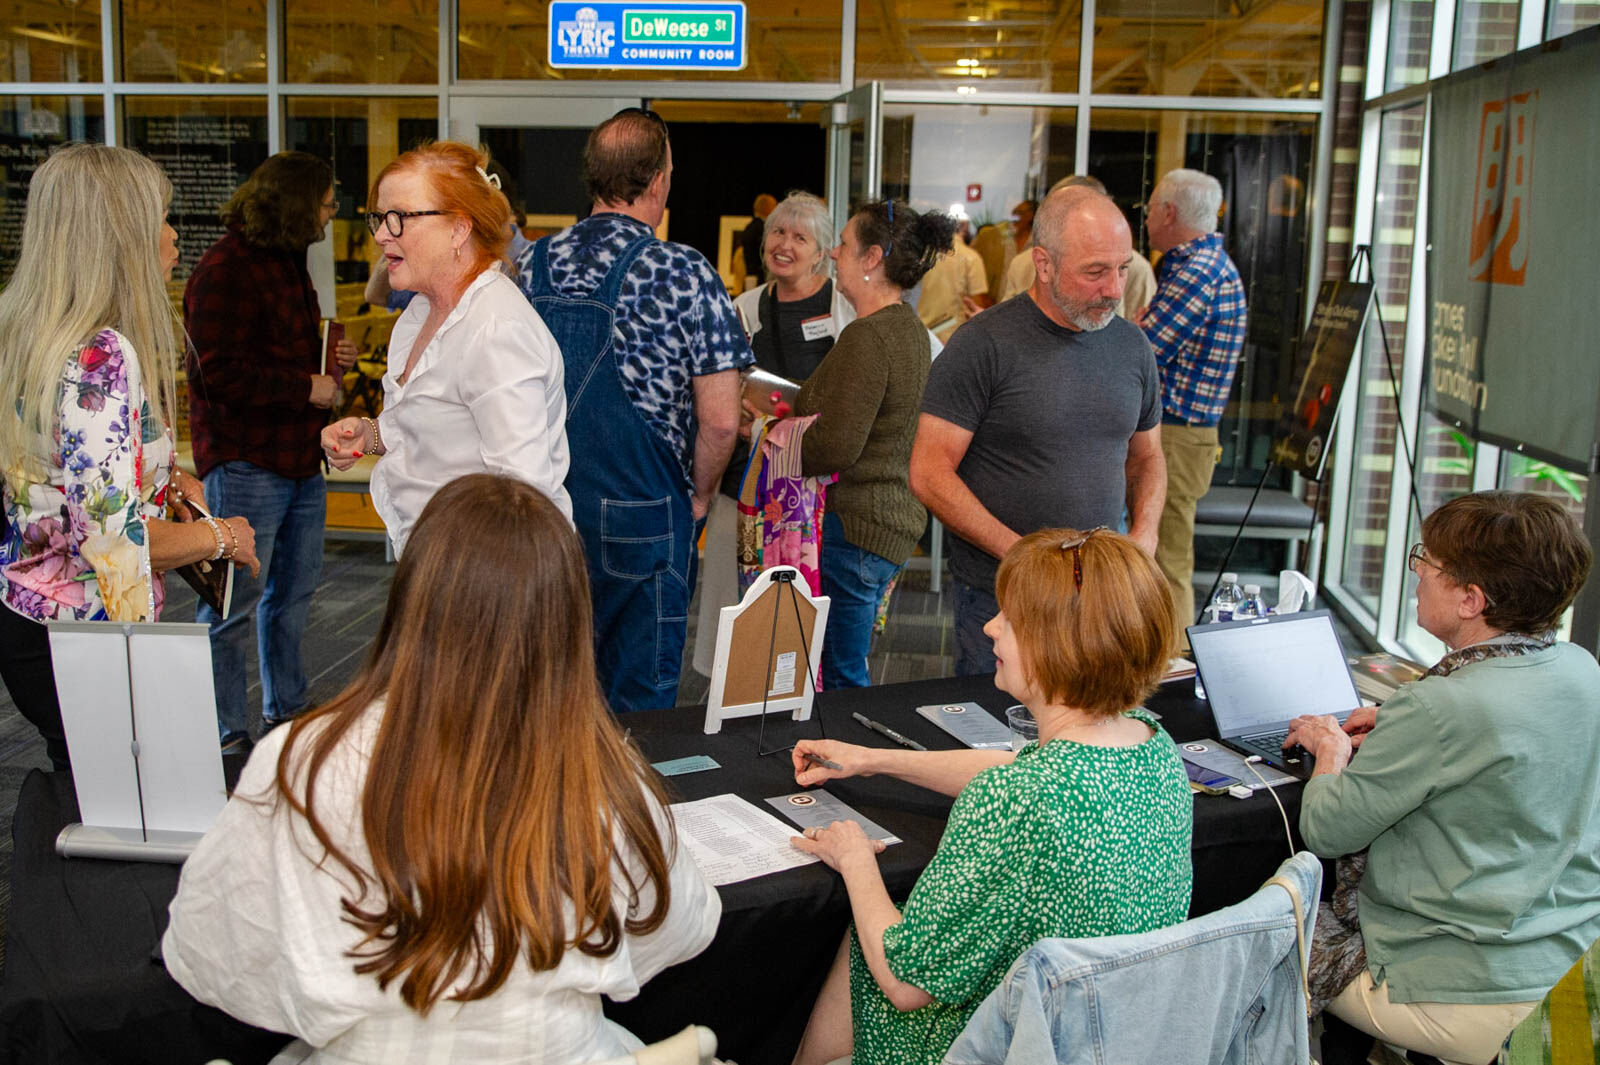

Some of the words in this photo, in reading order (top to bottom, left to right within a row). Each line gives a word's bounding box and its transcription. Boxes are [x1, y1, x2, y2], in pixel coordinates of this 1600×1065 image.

[578, 21, 595, 31] THE
[630, 17, 709, 37] DeWeese
[714, 19, 727, 31] St
[558, 27, 616, 48] LYRIC
[563, 46, 610, 56] THEATRE
[621, 48, 693, 60] COMMUNITY
[698, 49, 735, 60] ROOM
